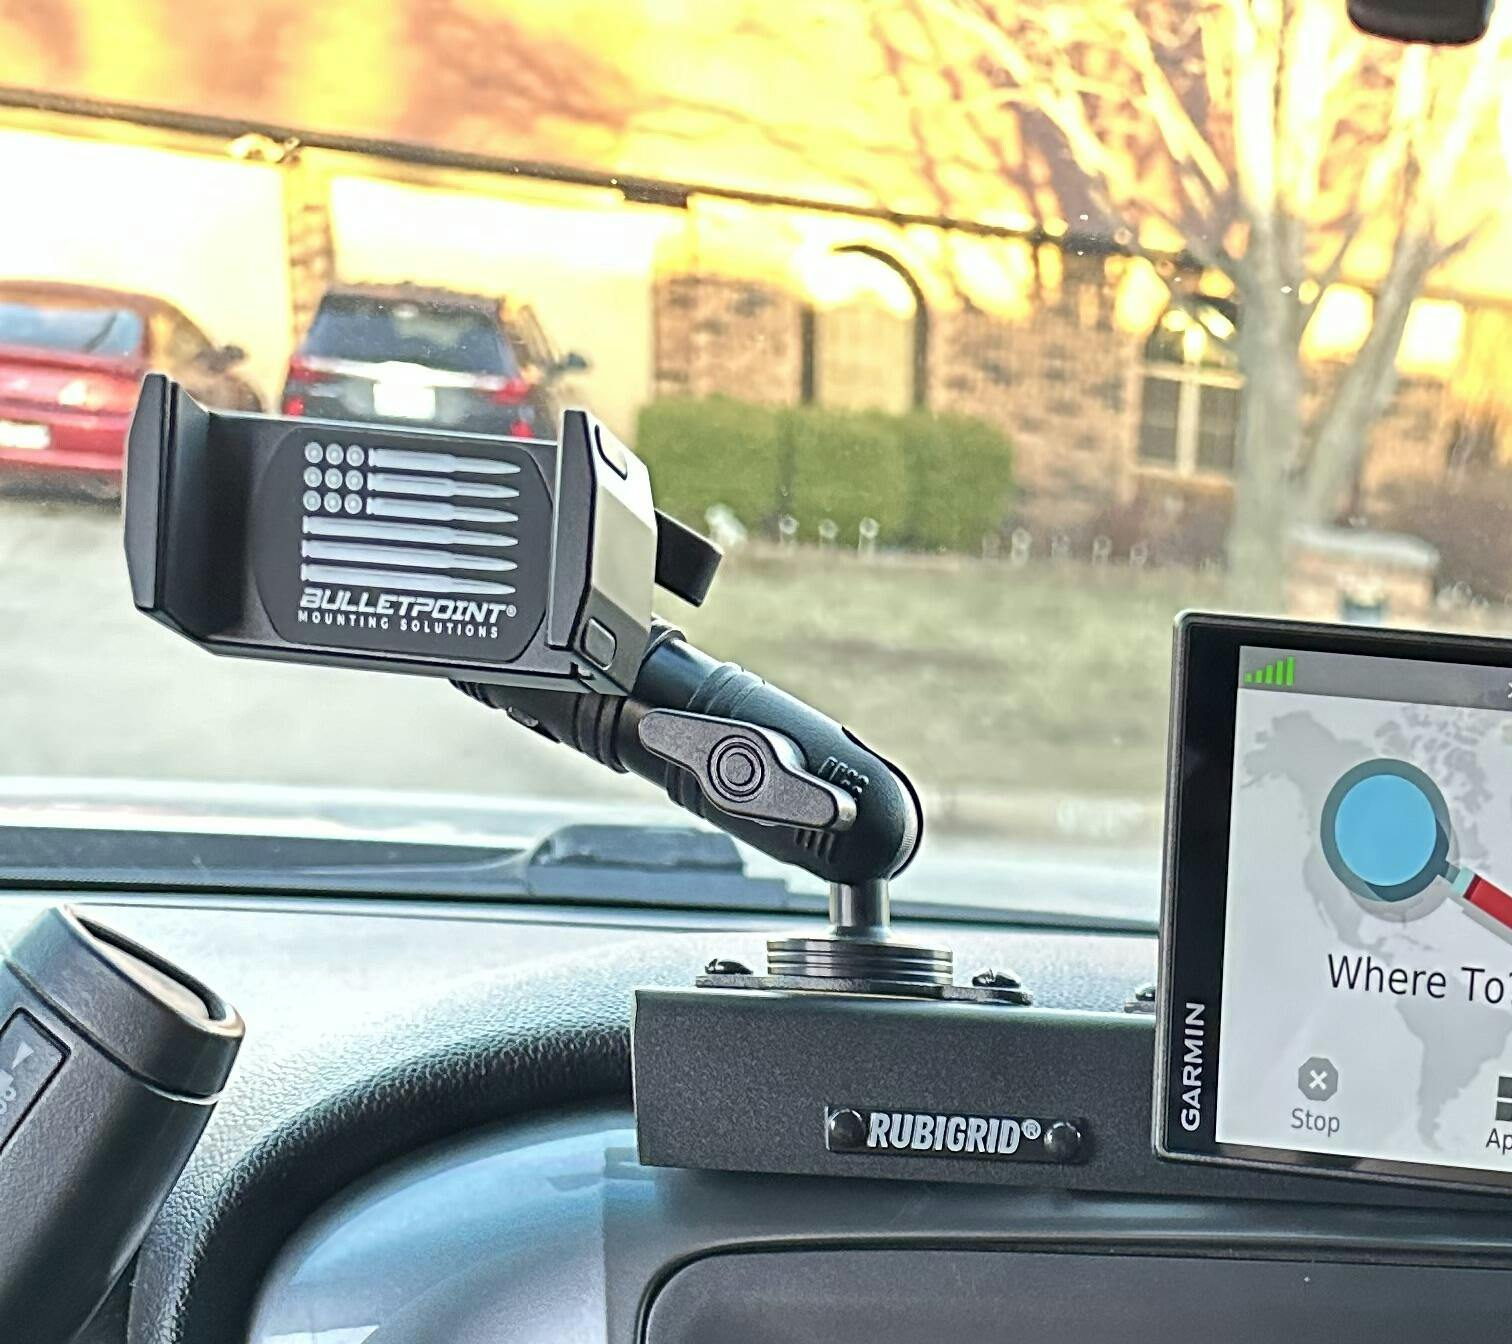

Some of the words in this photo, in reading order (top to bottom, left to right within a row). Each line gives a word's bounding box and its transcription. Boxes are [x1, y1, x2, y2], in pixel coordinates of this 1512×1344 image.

[297, 610, 389, 630] MOUNTING
[400, 618, 499, 639] SOLUTIONS
[1328, 953, 1446, 999] Where
[1180, 1002, 1206, 1132] GARMIN
[1290, 1107, 1341, 1138] Stop
